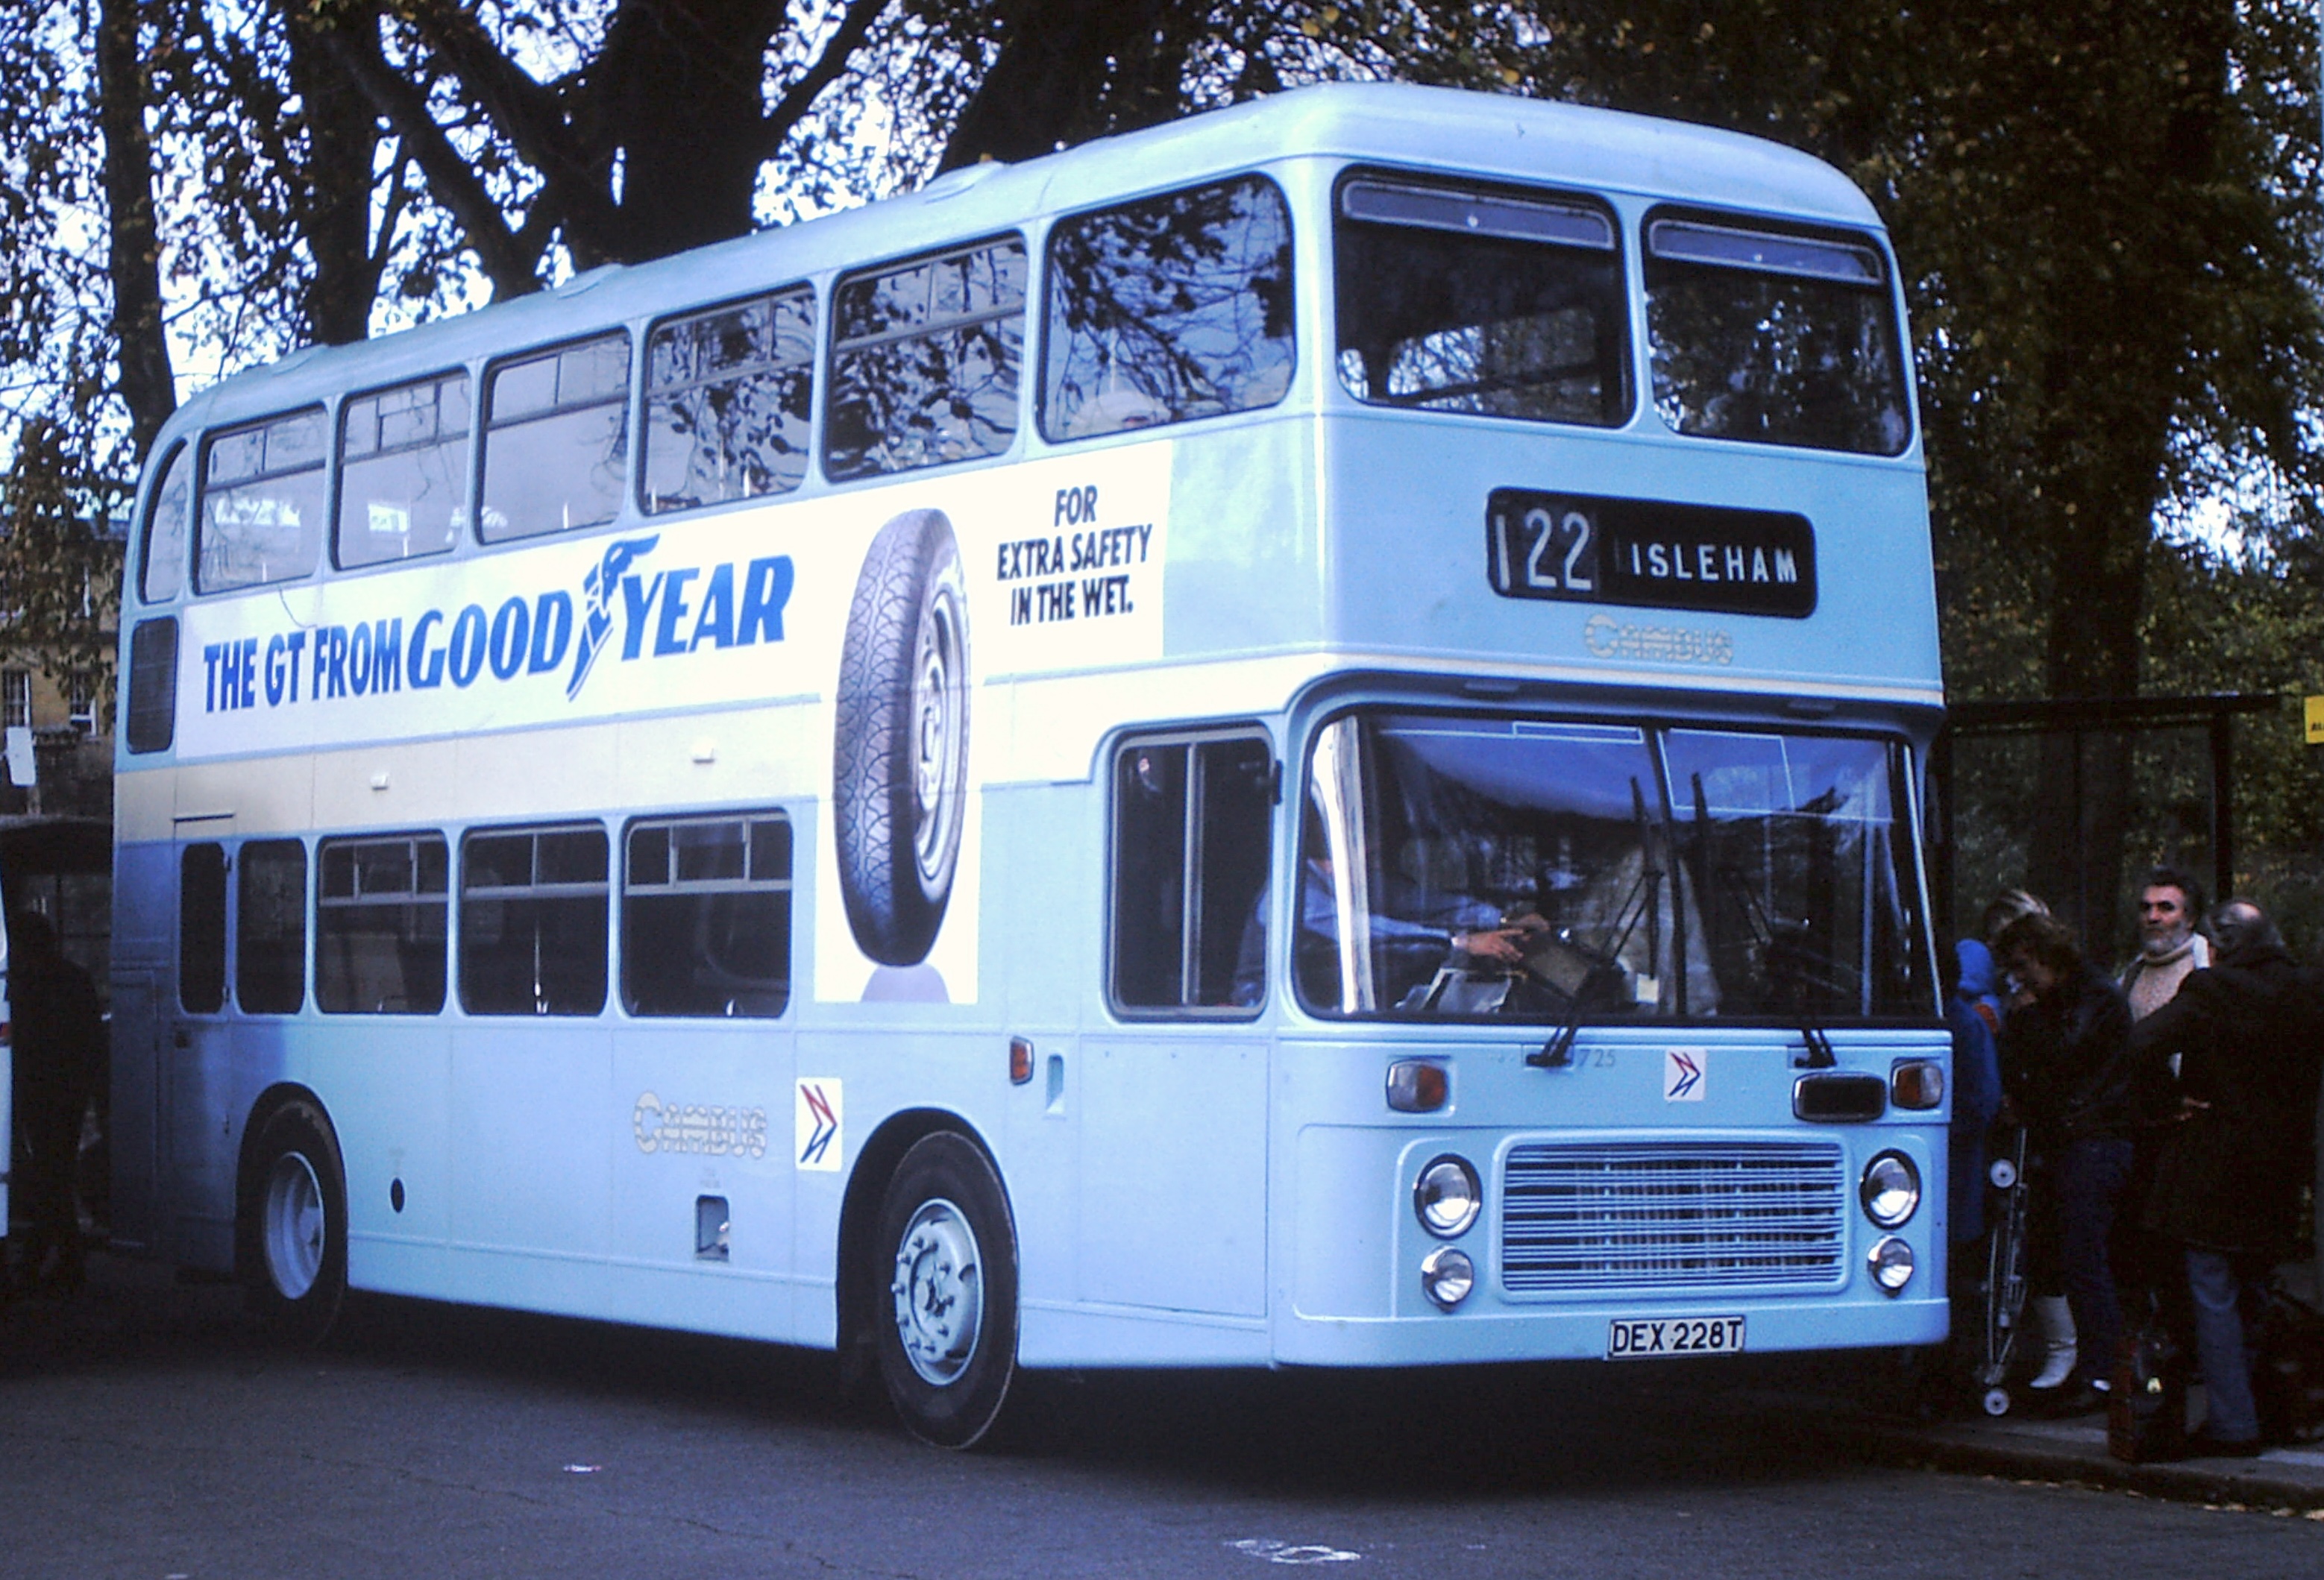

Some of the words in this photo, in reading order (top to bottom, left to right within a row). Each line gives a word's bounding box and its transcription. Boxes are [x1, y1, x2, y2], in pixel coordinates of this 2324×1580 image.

[1054, 485, 1099, 527] FOR
[996, 537, 1065, 581] EXTRA
[1069, 523, 1153, 572] SAFETY
[1495, 508, 1594, 592] 122
[1631, 542, 1798, 584] ISLEHAM
[1010, 585, 1033, 626] IN
[1037, 581, 1075, 623] THE
[1081, 573, 1134, 617] WET.
[204, 637, 258, 713] THE
[265, 631, 307, 708] GT
[311, 617, 403, 702] FROM
[1612, 1322, 1666, 1352] DEX
[1672, 1320, 1743, 1350] 228T
